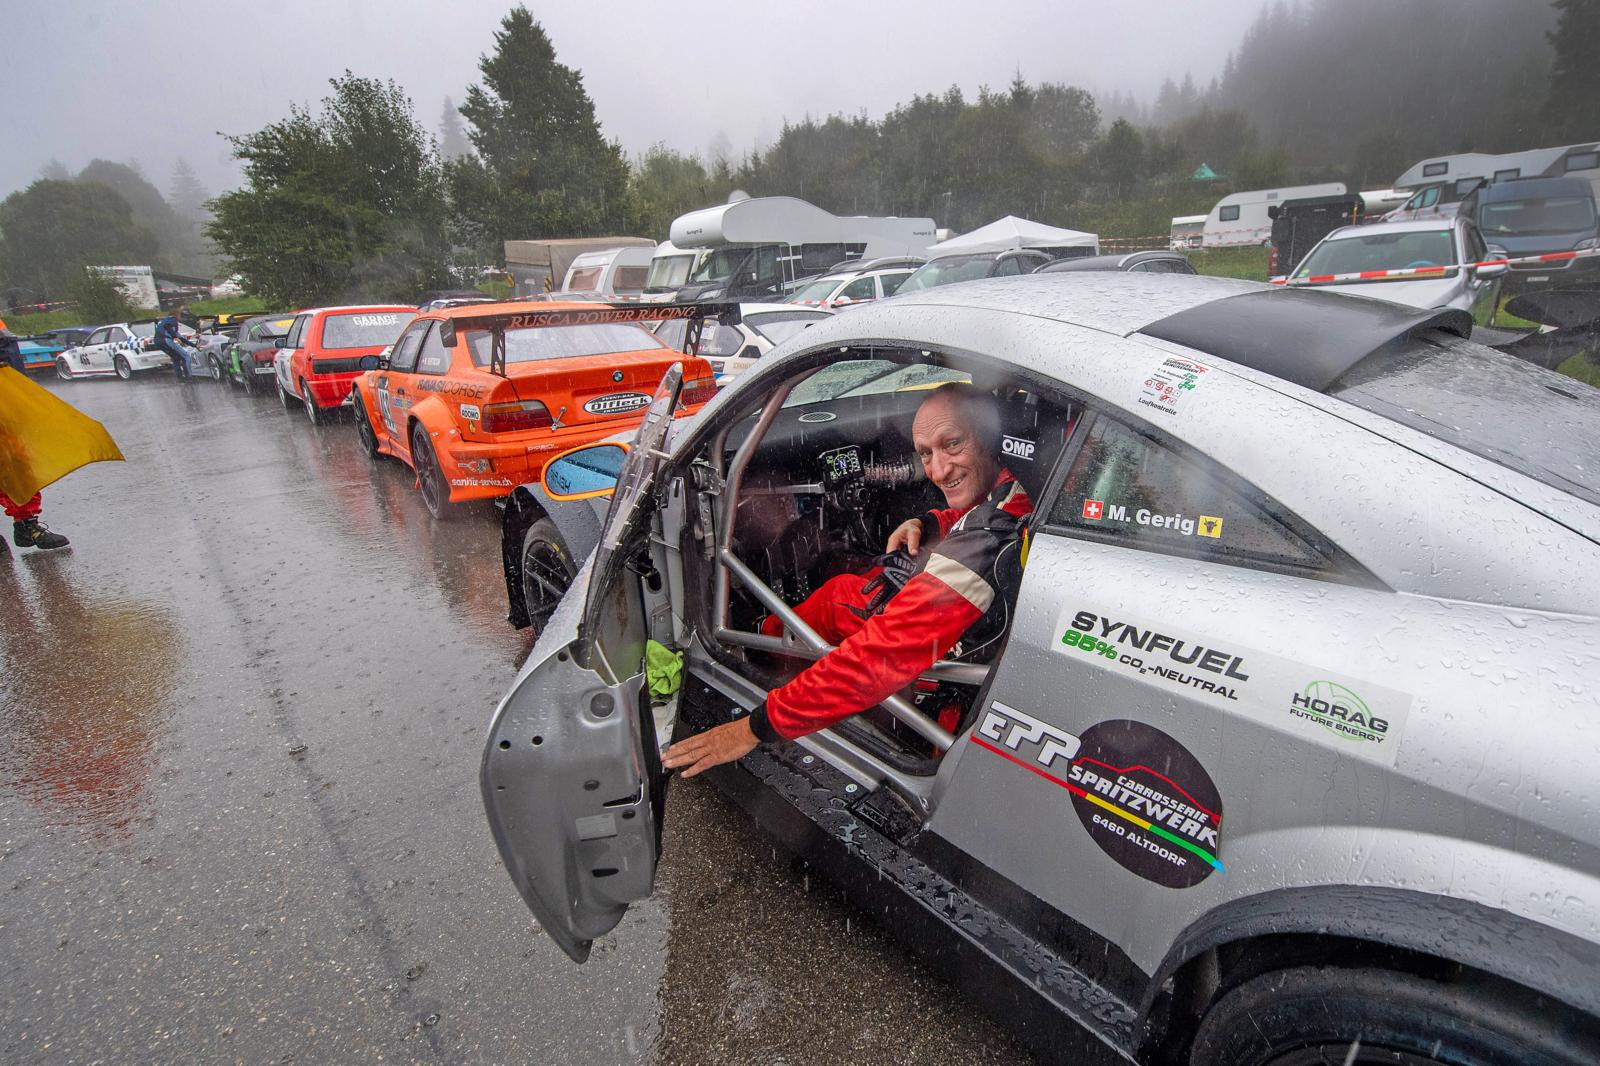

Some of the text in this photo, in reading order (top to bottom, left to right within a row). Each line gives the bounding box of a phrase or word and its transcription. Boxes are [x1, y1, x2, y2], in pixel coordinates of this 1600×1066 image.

[352, 315, 399, 326] GARAGE
[510, 306, 697, 328] RUSCA POWER RACING
[1138, 397, 1177, 415] Laufkontrolle
[1003, 438, 1035, 457] OMP
[1108, 505, 1194, 536] M. Gerig
[1062, 629, 1118, 661] 85%
[1071, 610, 1250, 682] SYNFUEL
[1289, 708, 1385, 744] FUTURE ENERGY
[1292, 692, 1389, 734] HORAG
[1068, 764, 1218, 849] SPRITZWERK
[1092, 813, 1188, 868] 6460 ALTDORF
